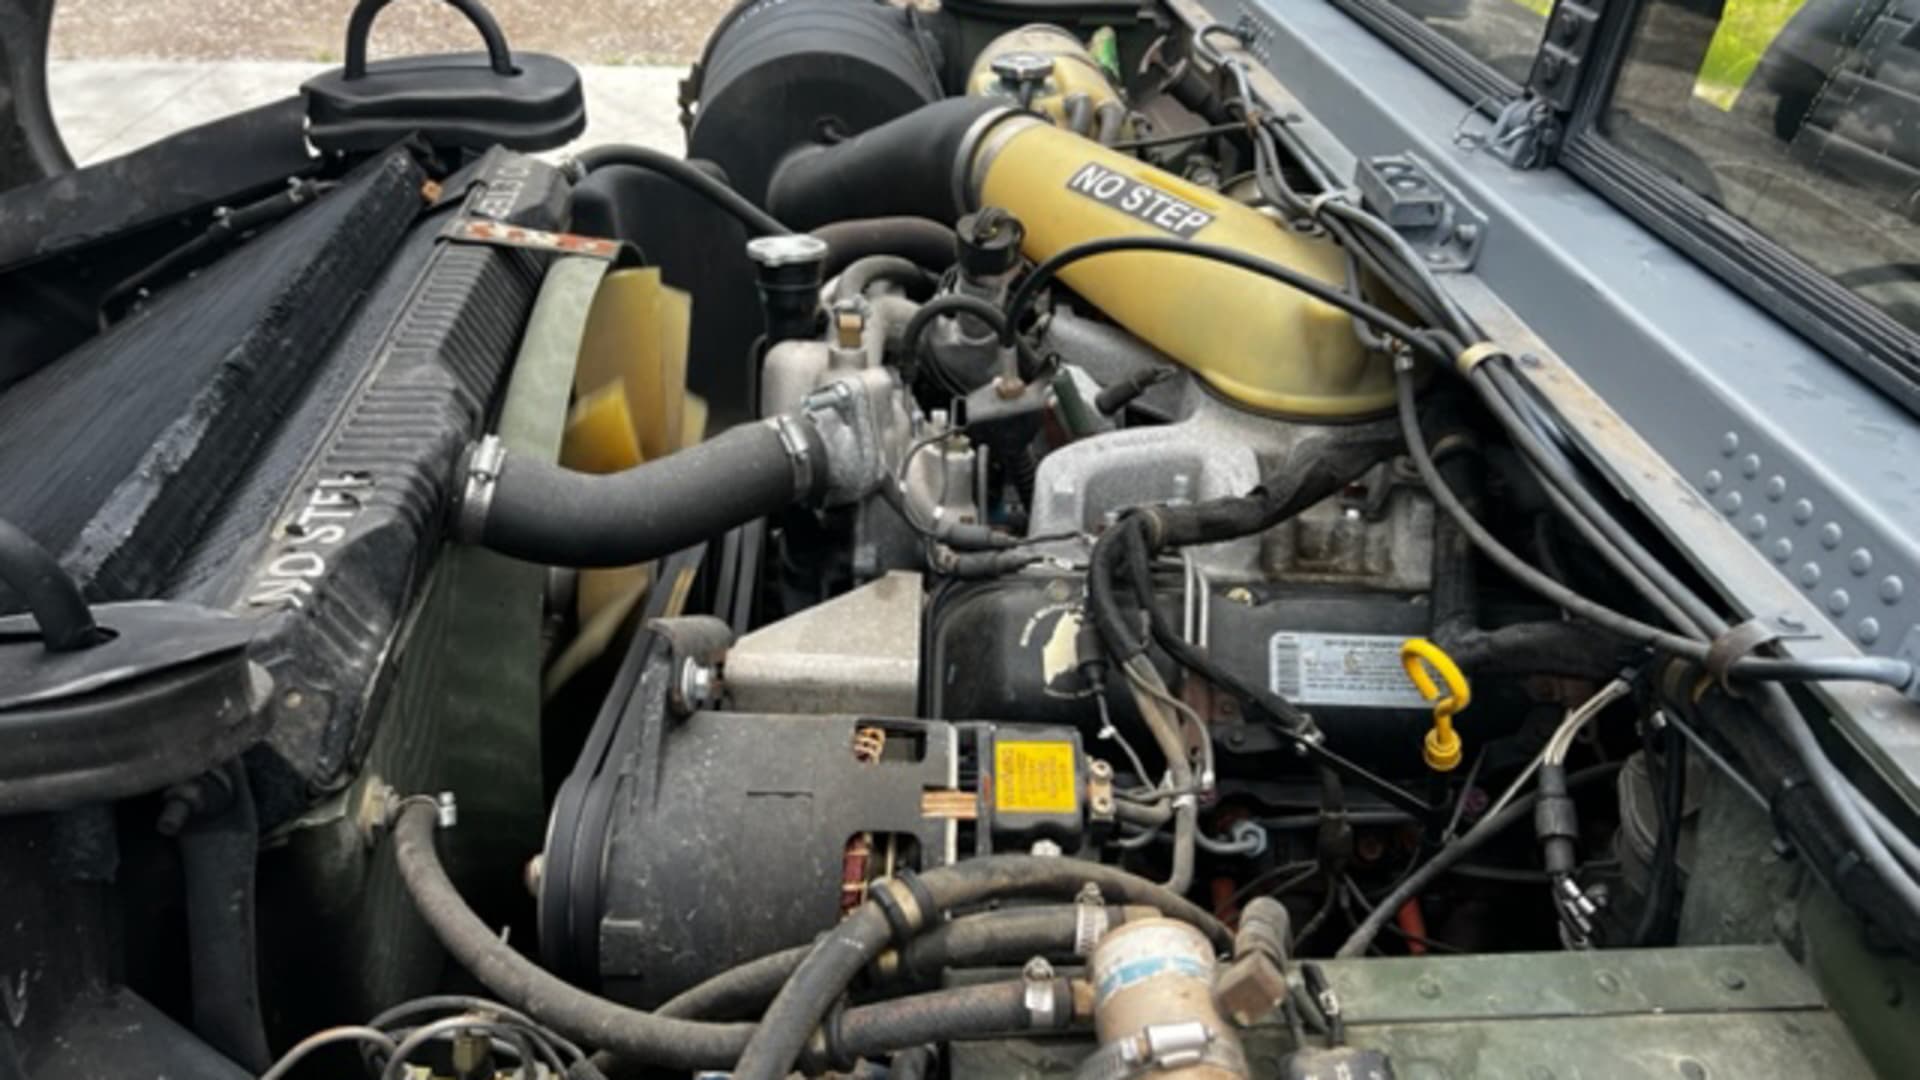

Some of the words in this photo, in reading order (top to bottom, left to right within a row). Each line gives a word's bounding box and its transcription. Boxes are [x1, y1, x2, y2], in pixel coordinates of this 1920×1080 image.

[1072, 164, 1127, 199] NO
[1120, 186, 1210, 232] STEP
[248, 551, 326, 608] NO
